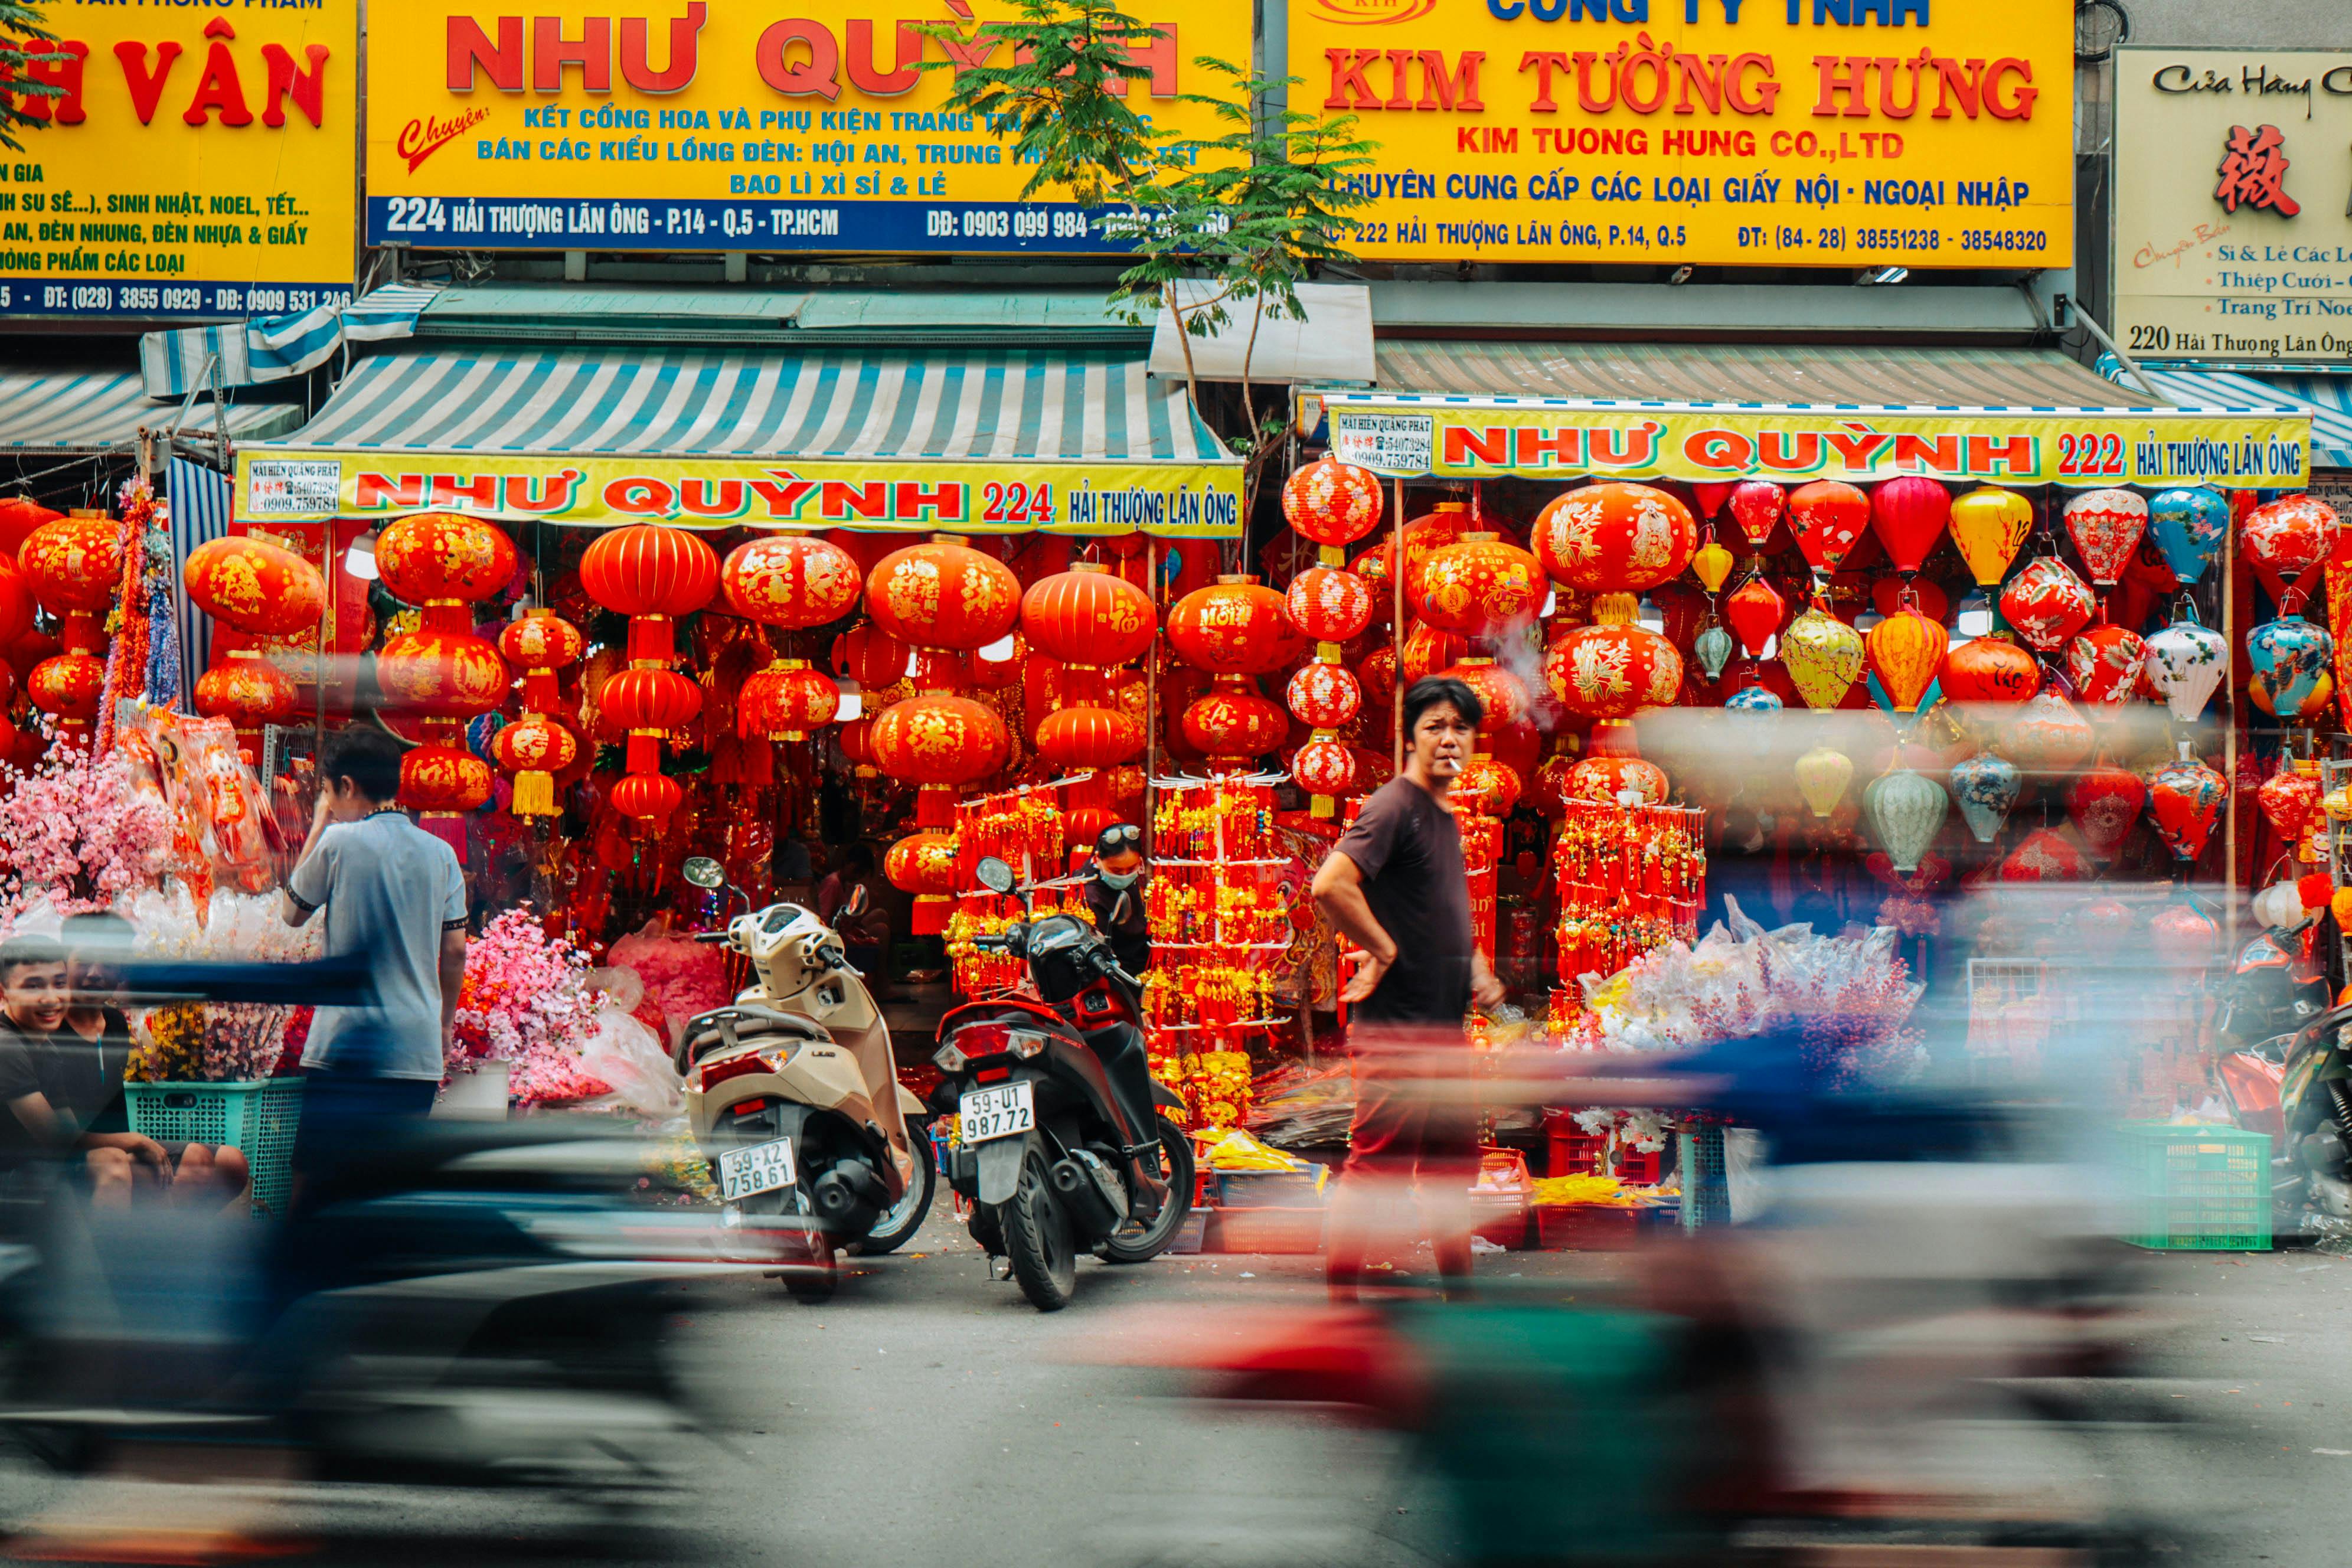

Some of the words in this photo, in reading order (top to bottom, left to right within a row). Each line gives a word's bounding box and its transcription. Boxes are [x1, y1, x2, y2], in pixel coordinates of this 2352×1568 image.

[446, 1, 707, 94] NHƯ
[113, 15, 331, 128] VÂN
[1324, 48, 1486, 114] KIM
[1518, 31, 1781, 116] TƯỜNG
[1811, 47, 2039, 123] HƯNG
[2154, 66, 2233, 94] Cửa
[2242, 66, 2311, 120] Hàng
[524, 103, 570, 128] KẾT
[579, 102, 650, 129] CỔNG
[659, 109, 710, 129] HOA
[718, 107, 751, 129] VÀ
[763, 110, 811, 133] PHỤ
[821, 109, 881, 134] KIỆN
[891, 112, 974, 132] TRANG
[397, 107, 489, 176] Chuyên:
[478, 136, 530, 159] BÁN
[540, 137, 590, 160] CÁC
[600, 134, 658, 161] KIỂU
[668, 136, 734, 161] LỒNG
[743, 139, 802, 161] ĐÈN:
[812, 141, 854, 166] HỘI
[864, 144, 907, 165] AN,
[916, 144, 1001, 164] TRUNG
[1457, 126, 1518, 153] KIM
[1532, 128, 1648, 156] TUONG
[1662, 129, 1756, 157] HUNG
[1770, 130, 1904, 163] CO.,LTD
[14, 164, 44, 182] GIA
[730, 175, 781, 194] BAO
[790, 171, 811, 194] LÌ
[821, 172, 845, 194] XÌ
[855, 169, 880, 195] SỈ
[890, 177, 908, 195] &
[918, 171, 946, 195] LẺ
[22, 193, 45, 212] SU
[51, 190, 101, 214] SÊ...),
[107, 194, 149, 213] SINH
[155, 192, 204, 218] NHẬT,
[210, 196, 260, 217] NOEL,
[266, 192, 309, 215] TẾT...
[1328, 168, 1436, 198] CHUYÊN
[1446, 174, 1518, 200] CUNG
[1528, 167, 1580, 200] CẤP
[1591, 171, 1641, 201] CÁC
[1654, 177, 1710, 207] LOẠI
[1723, 169, 1781, 202] GIẤY
[1796, 173, 1839, 208] NỘI
[1864, 179, 1945, 210] NGOẠI
[1957, 178, 2029, 211] NHẬP
[3, 223, 33, 243] AN,
[38, 220, 74, 241] ĐÈN
[80, 223, 147, 244] NHUNG,
[152, 221, 188, 243] ĐÈN
[194, 224, 243, 247] NHỰA
[249, 226, 262, 244] &
[267, 220, 308, 245] GIẤY
[388, 197, 446, 231] 224
[453, 197, 484, 232] HẢI
[489, 204, 563, 239] THƯỢNG
[569, 202, 605, 233] LÃN
[611, 202, 649, 234] ÔNG
[668, 208, 705, 234] P.14
[724, 208, 753, 237] Q.5
[771, 209, 838, 236] TP.HCM
[927, 211, 958, 236] DĐ:
[964, 211, 1009, 237] 0903
[1015, 211, 1048, 237] 099
[1054, 212, 1087, 237] 984
[1354, 223, 1387, 243] 222
[1397, 215, 1427, 243] HẢI
[1436, 220, 1510, 251] THƯỢNG
[1517, 220, 1551, 244] LÃN
[1560, 220, 1602, 250] ÔNG,
[1609, 225, 1649, 244] P.14,
[1657, 225, 1685, 246] Q.5
[2192, 218, 2232, 244] Bán
[1738, 226, 1766, 246] ĐT:
[1819, 228, 1845, 249] 28)
[1857, 228, 1939, 249] 38551238
[1962, 230, 2046, 250] 38548320
[47, 245, 99, 271] PHẨM
[104, 250, 140, 272] CÁC
[146, 253, 185, 276] LOẠI
[2240, 247, 2258, 262] &
[2266, 246, 2288, 262] Lẻ
[2292, 247, 2328, 263] Các
[2218, 271, 2279, 294] Thiệp
[2282, 273, 2332, 289] Cưới
[45, 286, 67, 308] ĐT:
[73, 287, 112, 310] (028)
[120, 288, 158, 309] 3855
[163, 288, 201, 309] 0929
[217, 289, 243, 311] DĐ:
[247, 289, 285, 311] 0909
[290, 290, 318, 311] 531
[2219, 298, 2278, 321] Trang
[2282, 297, 2311, 315] Trí
[2129, 325, 2170, 350] 220
[2177, 334, 2205, 350] Hải
[2286, 335, 2316, 351] Lãn
[2321, 331, 2352, 358] Ông
[1341, 416, 1355, 429] MÁI
[1358, 416, 1377, 430] HIÊN
[1409, 419, 1430, 432] PHÁT
[1444, 421, 1664, 468] NHƯ
[1683, 422, 2035, 474] QUỲNH
[2059, 433, 2122, 473] 222
[2138, 430, 2162, 475] HẢI
[2168, 439, 2229, 486] THƯỢNG
[2234, 436, 2263, 475] LÃN
[2269, 435, 2300, 475] ÔNG
[268, 463, 285, 476] HIÊN
[317, 463, 338, 477] PHÁT
[357, 469, 583, 514] NHƯ
[603, 468, 968, 522] QUỲNH
[984, 482, 1051, 521] 224
[1070, 477, 1097, 524] HẢI
[1101, 485, 1165, 530] THƯỢNG
[1169, 485, 1200, 525] LÃN
[1205, 485, 1236, 525] ÔNG
[1200, 604, 1236, 626] Mới
[972, 1087, 1020, 1115] 59-U1
[967, 1107, 1031, 1139] 987.72
[731, 1143, 783, 1174] 59-X2
[727, 1162, 790, 1197] 758.61
